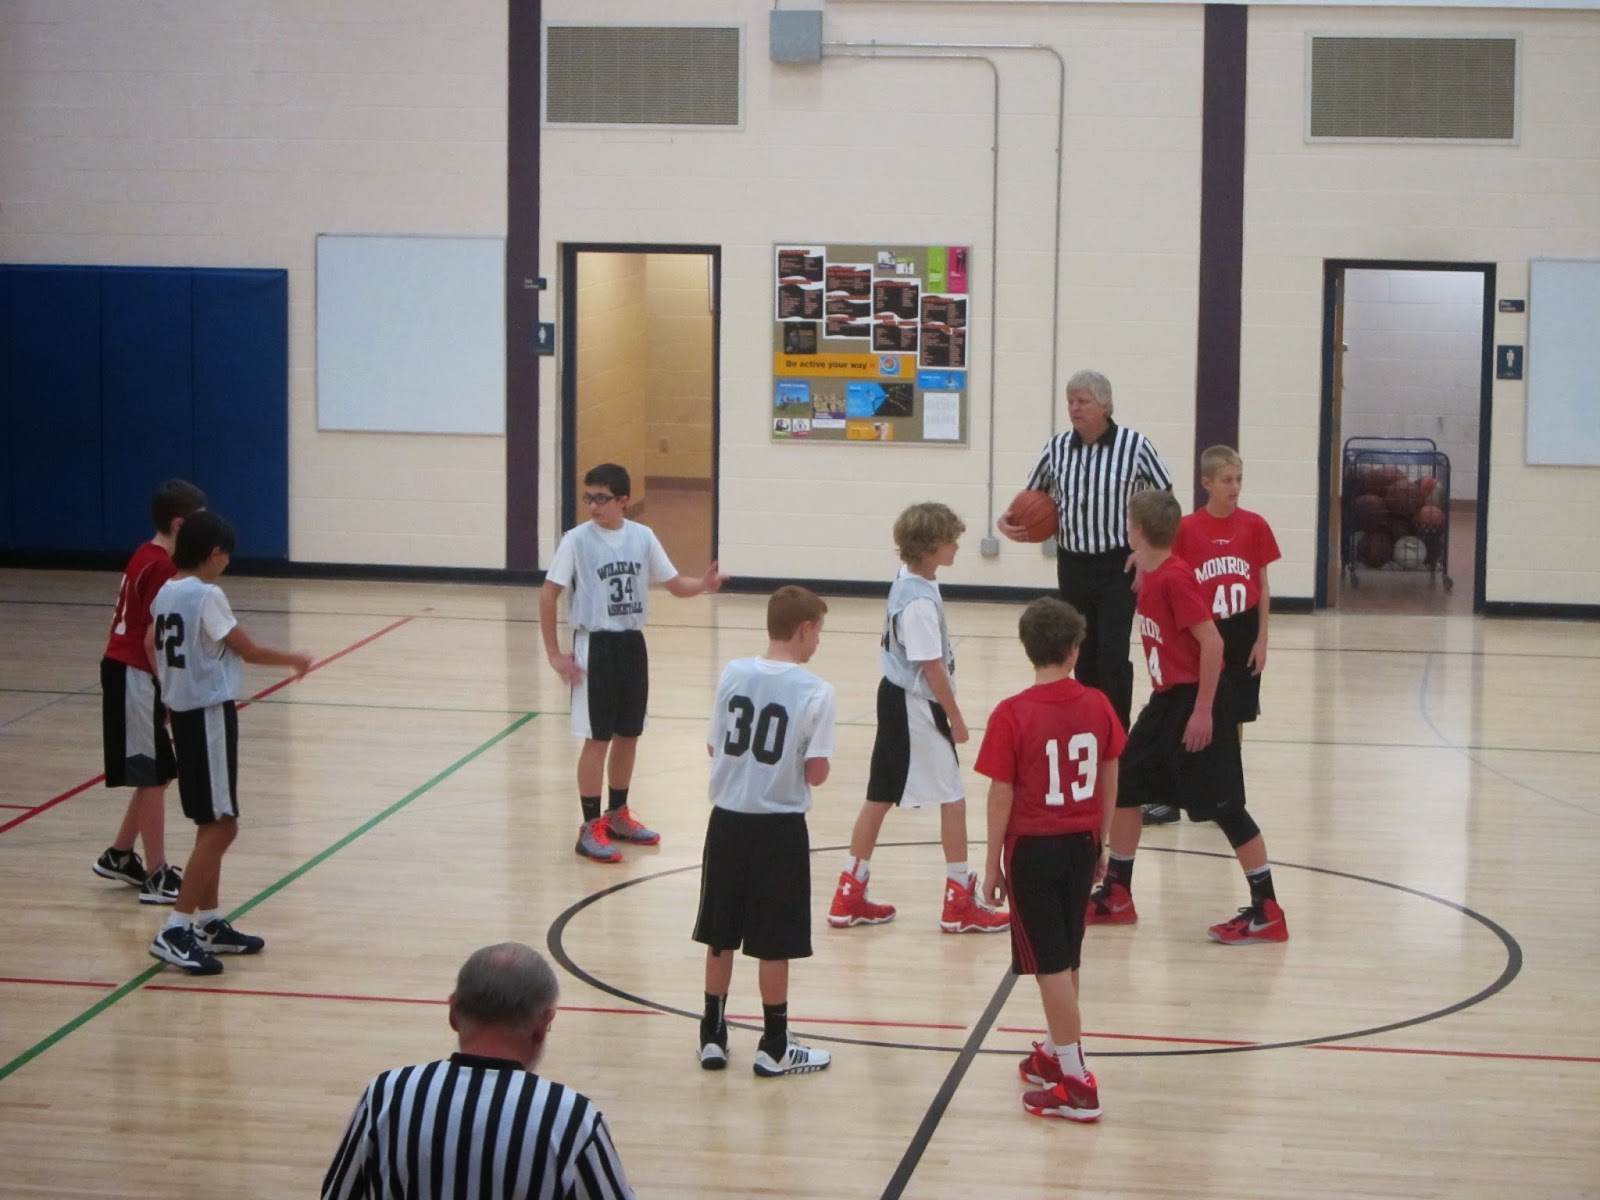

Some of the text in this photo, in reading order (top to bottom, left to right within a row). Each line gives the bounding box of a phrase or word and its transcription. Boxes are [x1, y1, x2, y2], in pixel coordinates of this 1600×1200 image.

[785, 360, 798, 368] Be
[799, 361, 826, 369] active
[828, 362, 848, 370] your
[1194, 555, 1251, 584] MONROE
[609, 576, 633, 602] 34
[1212, 582, 1247, 619] 40
[724, 694, 789, 766] 30
[1045, 732, 1098, 806] 13
